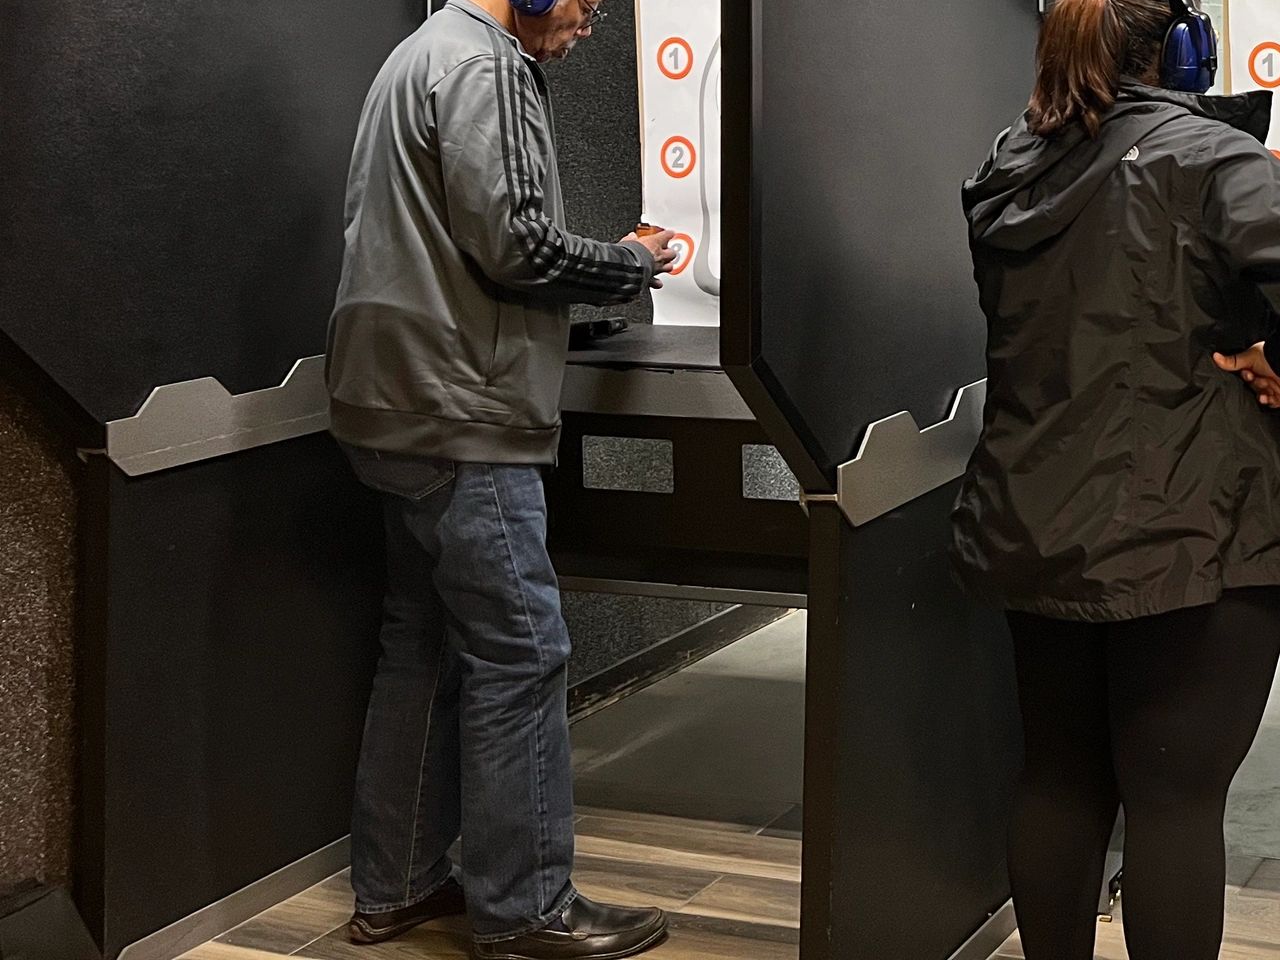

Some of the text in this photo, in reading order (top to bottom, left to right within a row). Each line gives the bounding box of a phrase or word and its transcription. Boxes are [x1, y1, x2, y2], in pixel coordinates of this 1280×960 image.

[669, 47, 679, 70] 1
[1262, 52, 1273, 78] 1
[671, 146, 684, 168] 2
